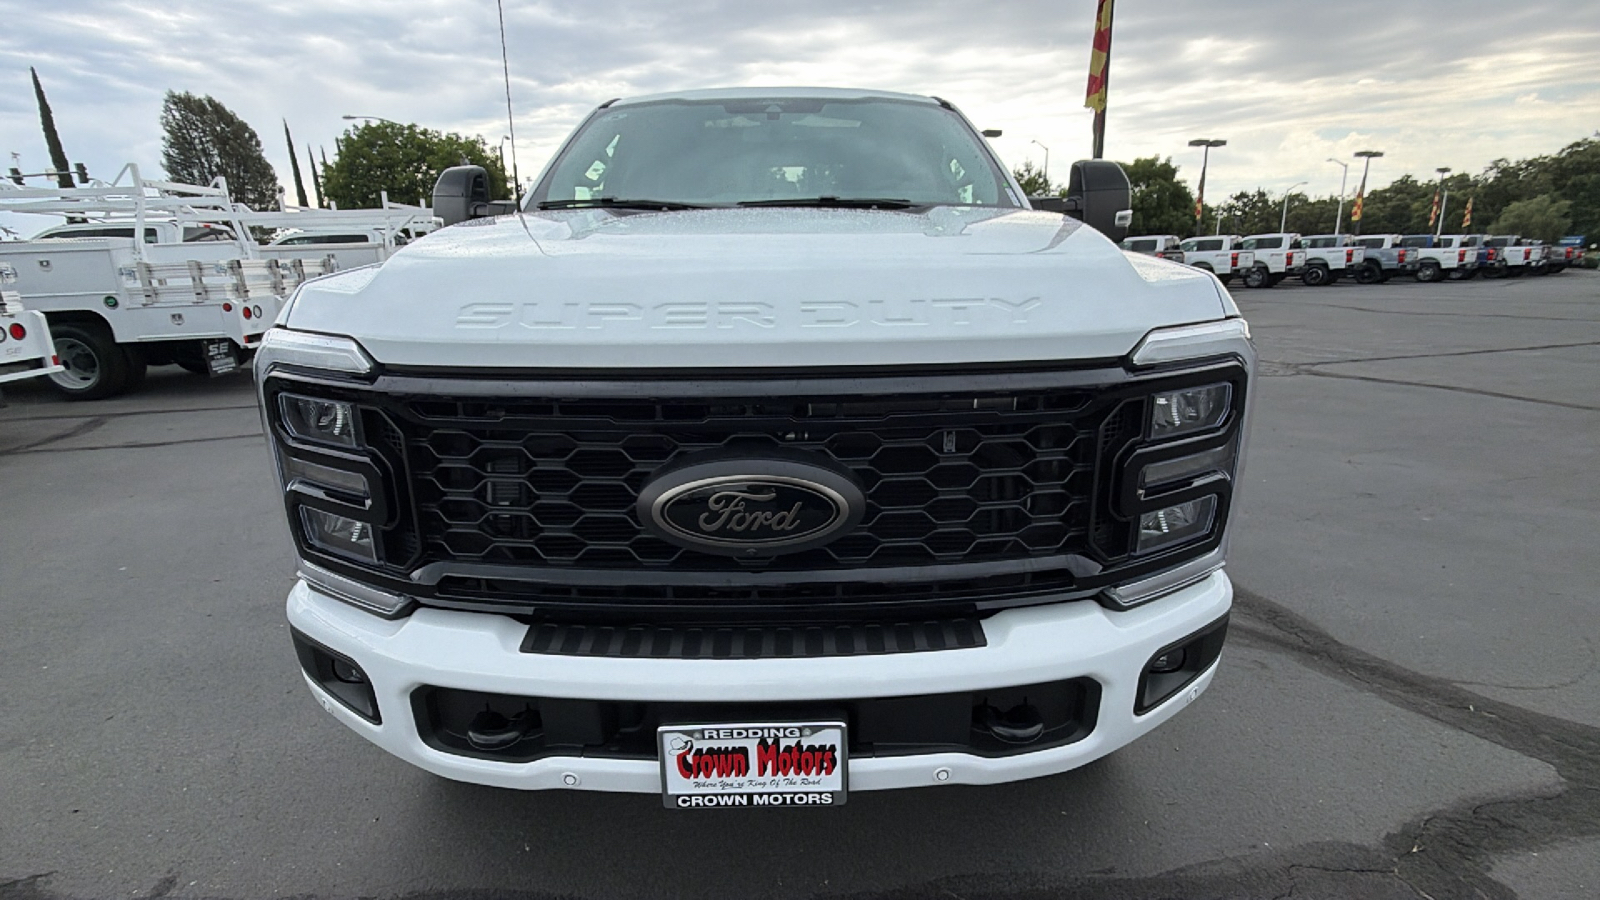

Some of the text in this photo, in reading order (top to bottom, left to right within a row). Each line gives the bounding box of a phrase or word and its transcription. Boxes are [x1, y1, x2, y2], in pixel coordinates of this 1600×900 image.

[455, 297, 1042, 330] SUPER DUTY
[208, 342, 229, 356] SE
[698, 491, 802, 532] Ford
[704, 727, 801, 739] REDDING
[676, 738, 837, 779] Crown Motors
[692, 781, 717, 789] Where
[747, 779, 767, 788] King
[782, 778, 797, 786] The
[799, 777, 822, 786] Road
[677, 793, 833, 807] CROWN MOTORS
